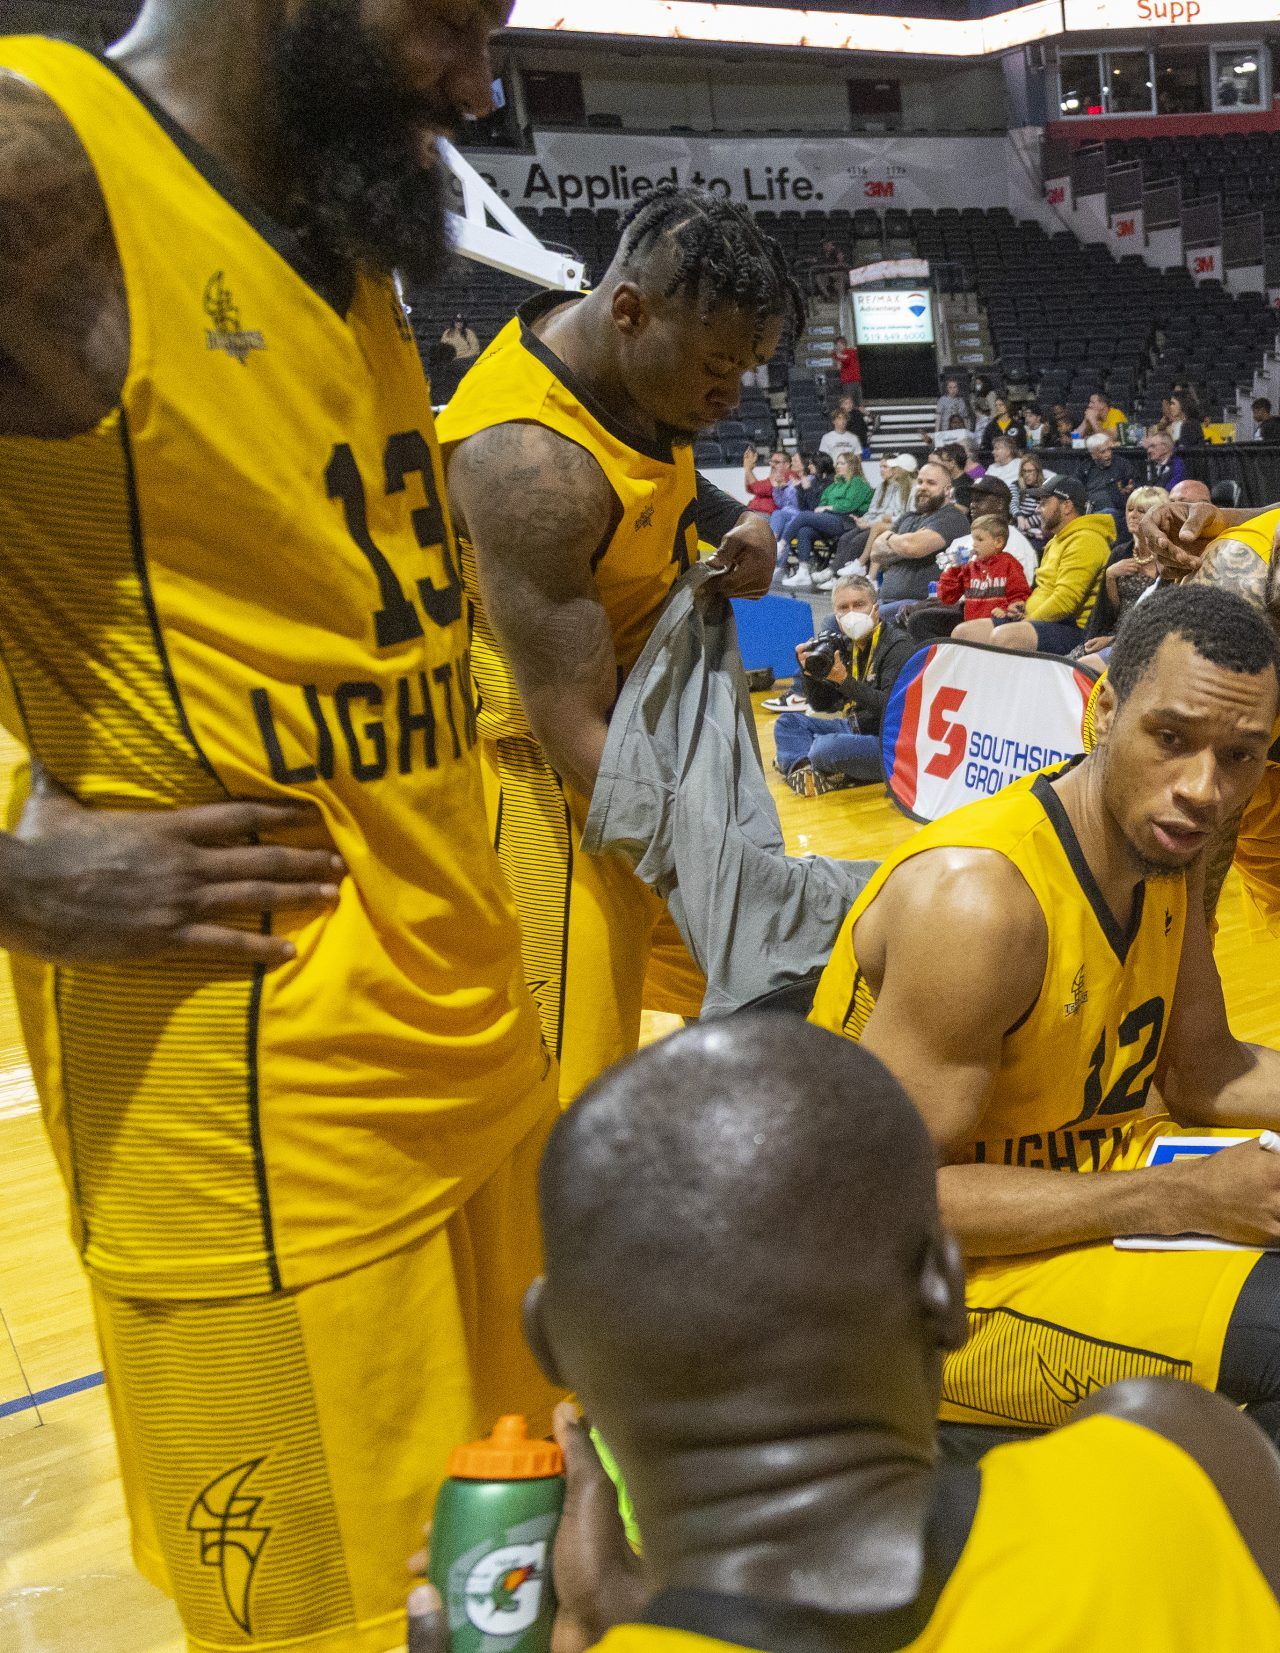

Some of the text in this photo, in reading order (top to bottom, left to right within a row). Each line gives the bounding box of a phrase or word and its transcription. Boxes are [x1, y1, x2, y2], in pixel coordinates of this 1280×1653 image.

[1137, 0, 1200, 23] Supp
[523, 163, 678, 206] Applied
[744, 167, 825, 200] Life.
[864, 181, 895, 198] 3M
[1047, 186, 1066, 204] 3M
[1117, 219, 1136, 238] 3M
[1194, 255, 1214, 274] 3M
[326, 431, 463, 648] 13
[968, 730, 1074, 772] SOUTHSID
[964, 761, 1021, 795] GROU
[1055, 996, 1165, 1131] 12
